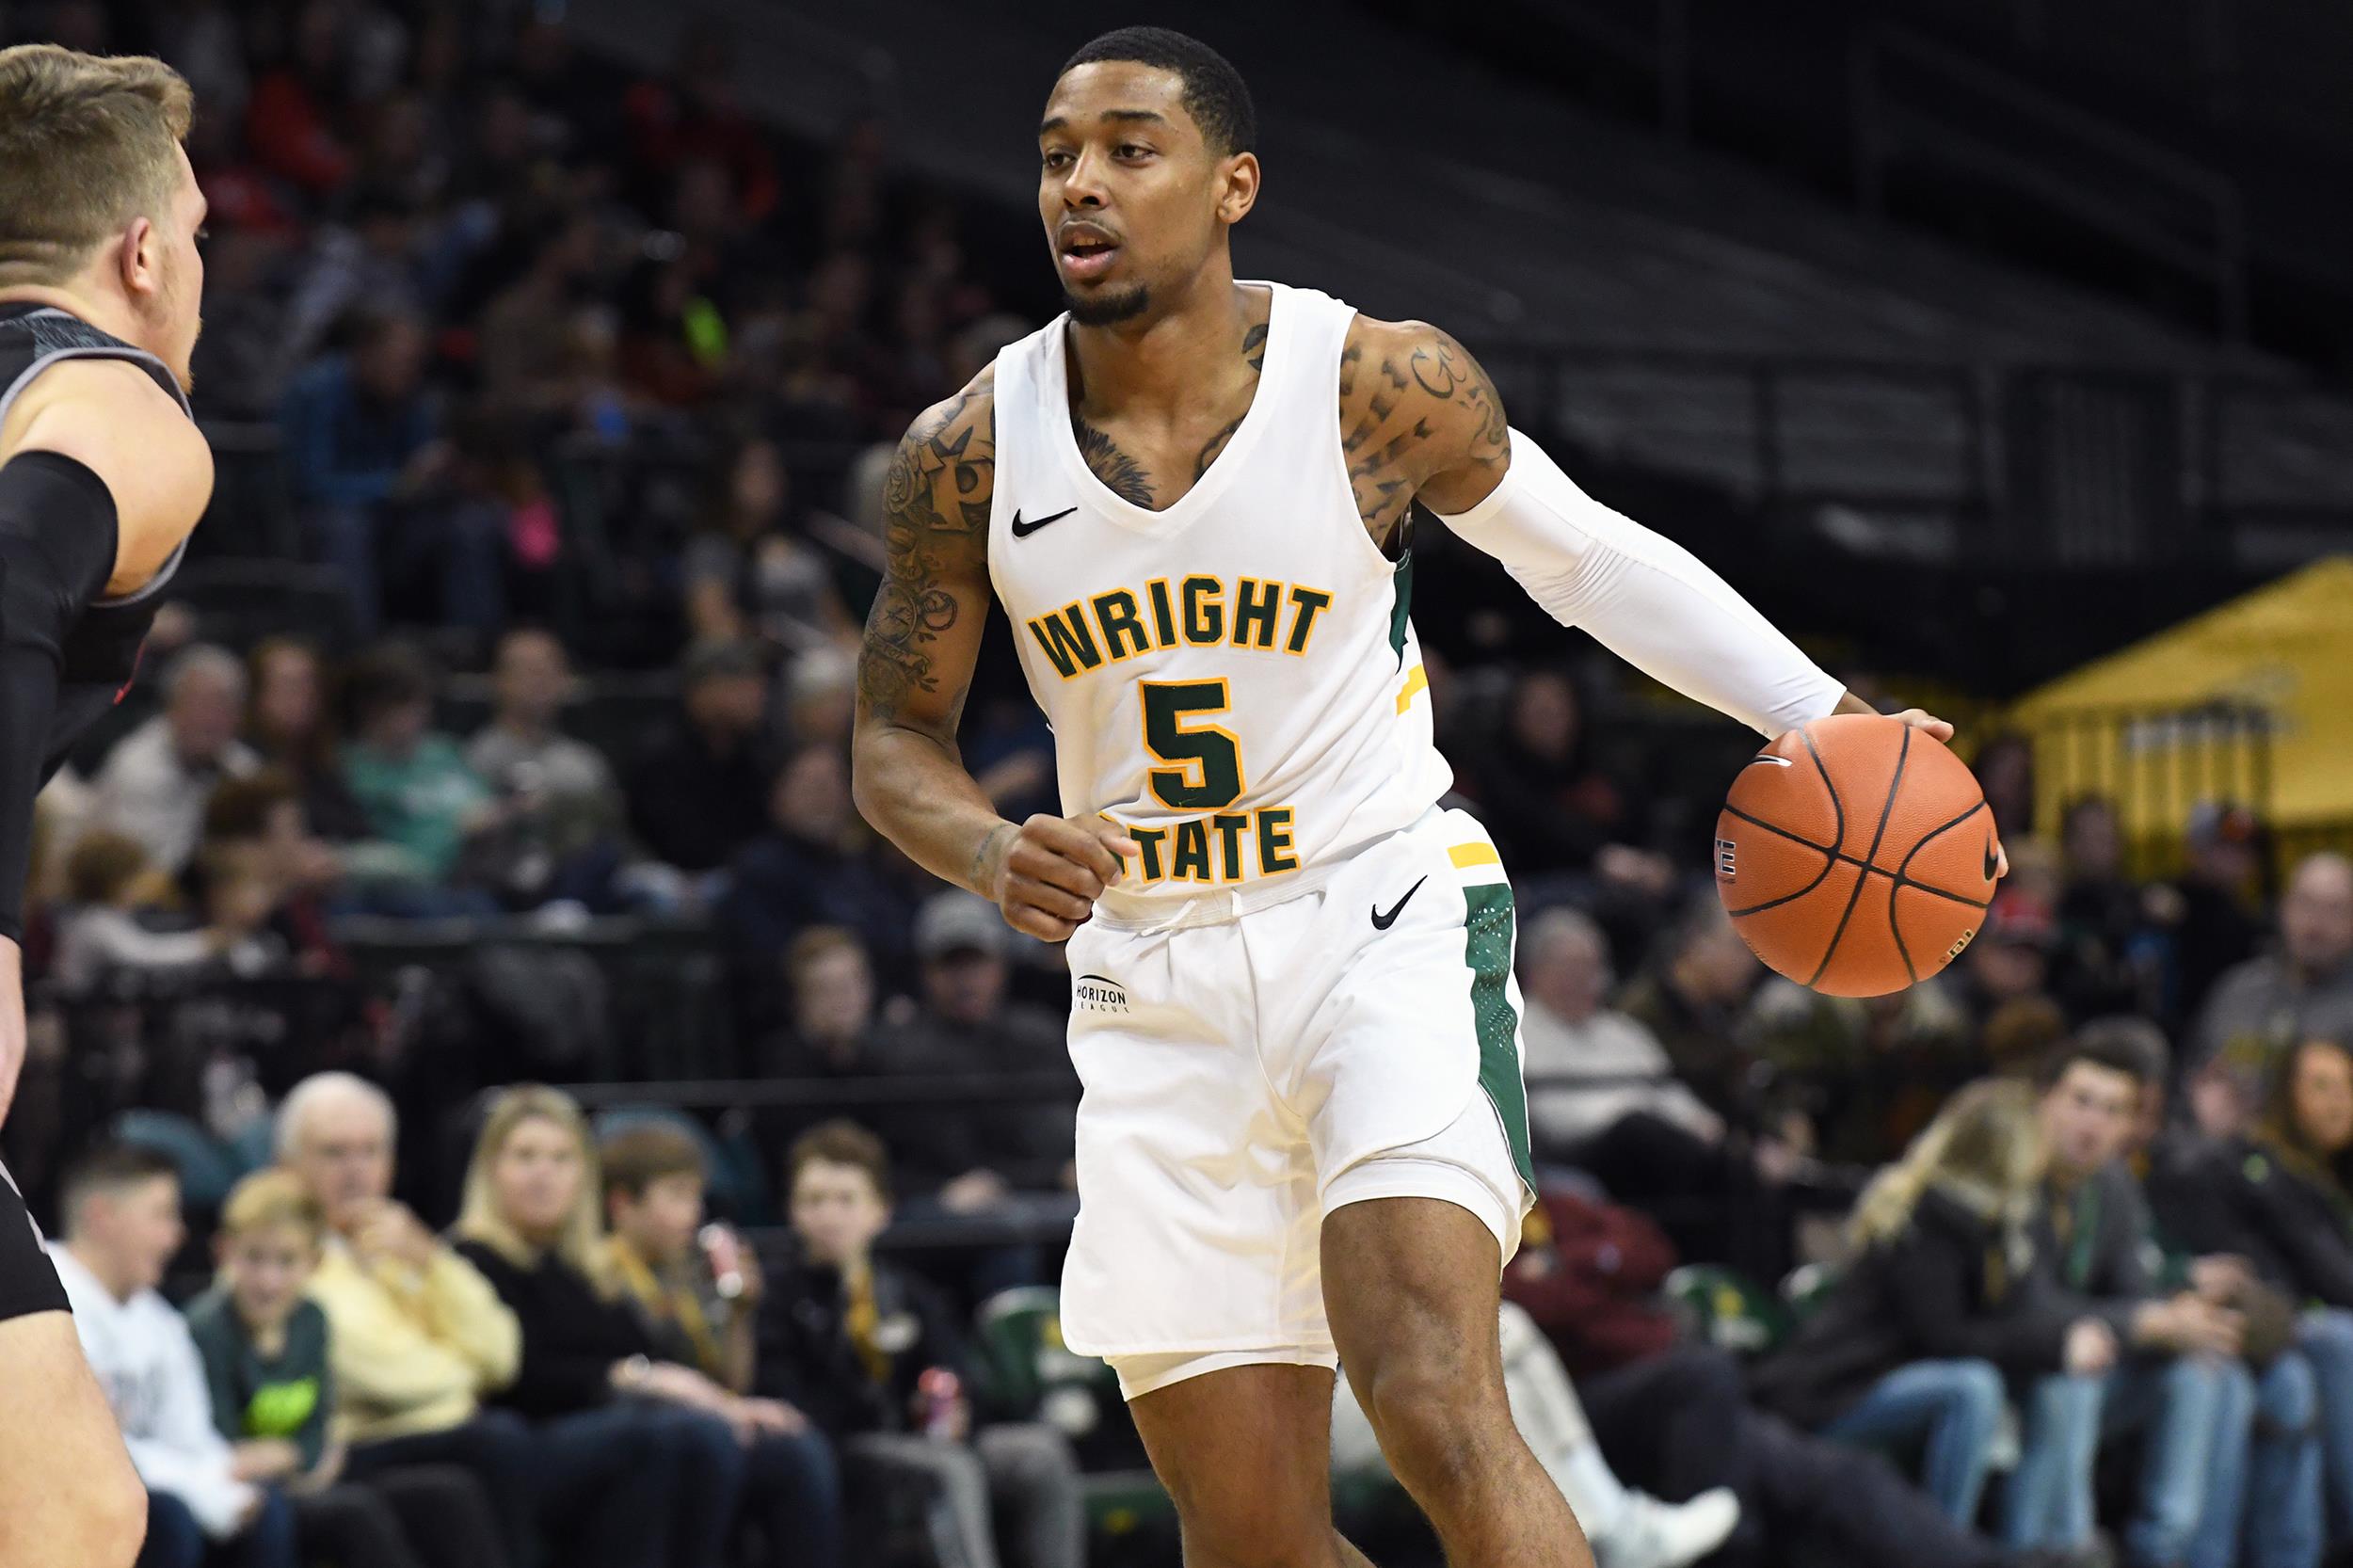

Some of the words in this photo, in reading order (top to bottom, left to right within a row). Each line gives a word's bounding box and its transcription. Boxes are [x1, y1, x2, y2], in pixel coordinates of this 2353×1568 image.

[1026, 573, 1335, 682] WRIGHT
[1138, 677, 1247, 811] 5
[1098, 806, 1301, 884] TATE
[1076, 984, 1127, 1005] HORIZON
